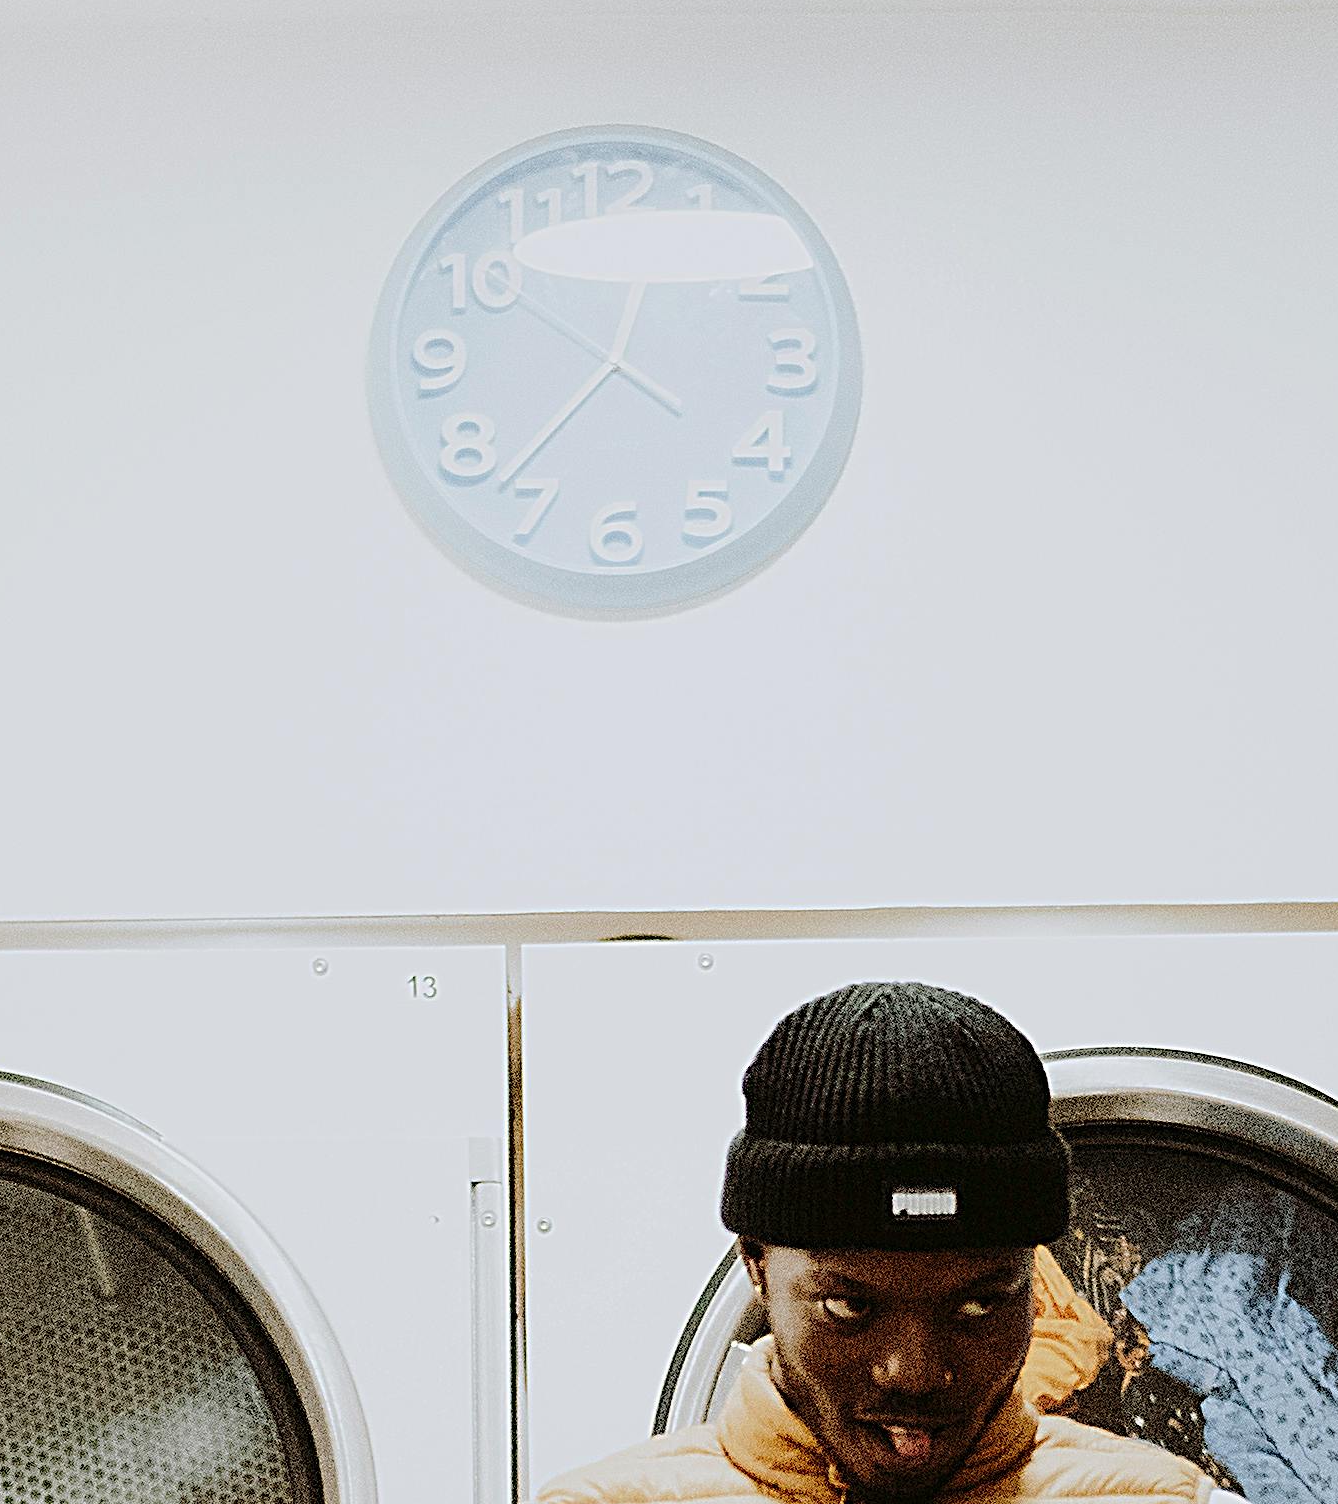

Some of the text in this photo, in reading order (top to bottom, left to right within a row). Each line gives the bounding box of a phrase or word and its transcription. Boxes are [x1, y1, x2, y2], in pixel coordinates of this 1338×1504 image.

[497, 187, 563, 242] 11
[572, 159, 654, 215] 12
[438, 250, 522, 309] 10
[412, 328, 466, 395] 9
[766, 327, 817, 392] 3
[439, 413, 496, 481] 8
[731, 410, 792, 476] 4
[513, 478, 559, 543] 7
[589, 502, 643, 566] 6
[681, 480, 733, 544] 5
[406, 975, 438, 998] 13
